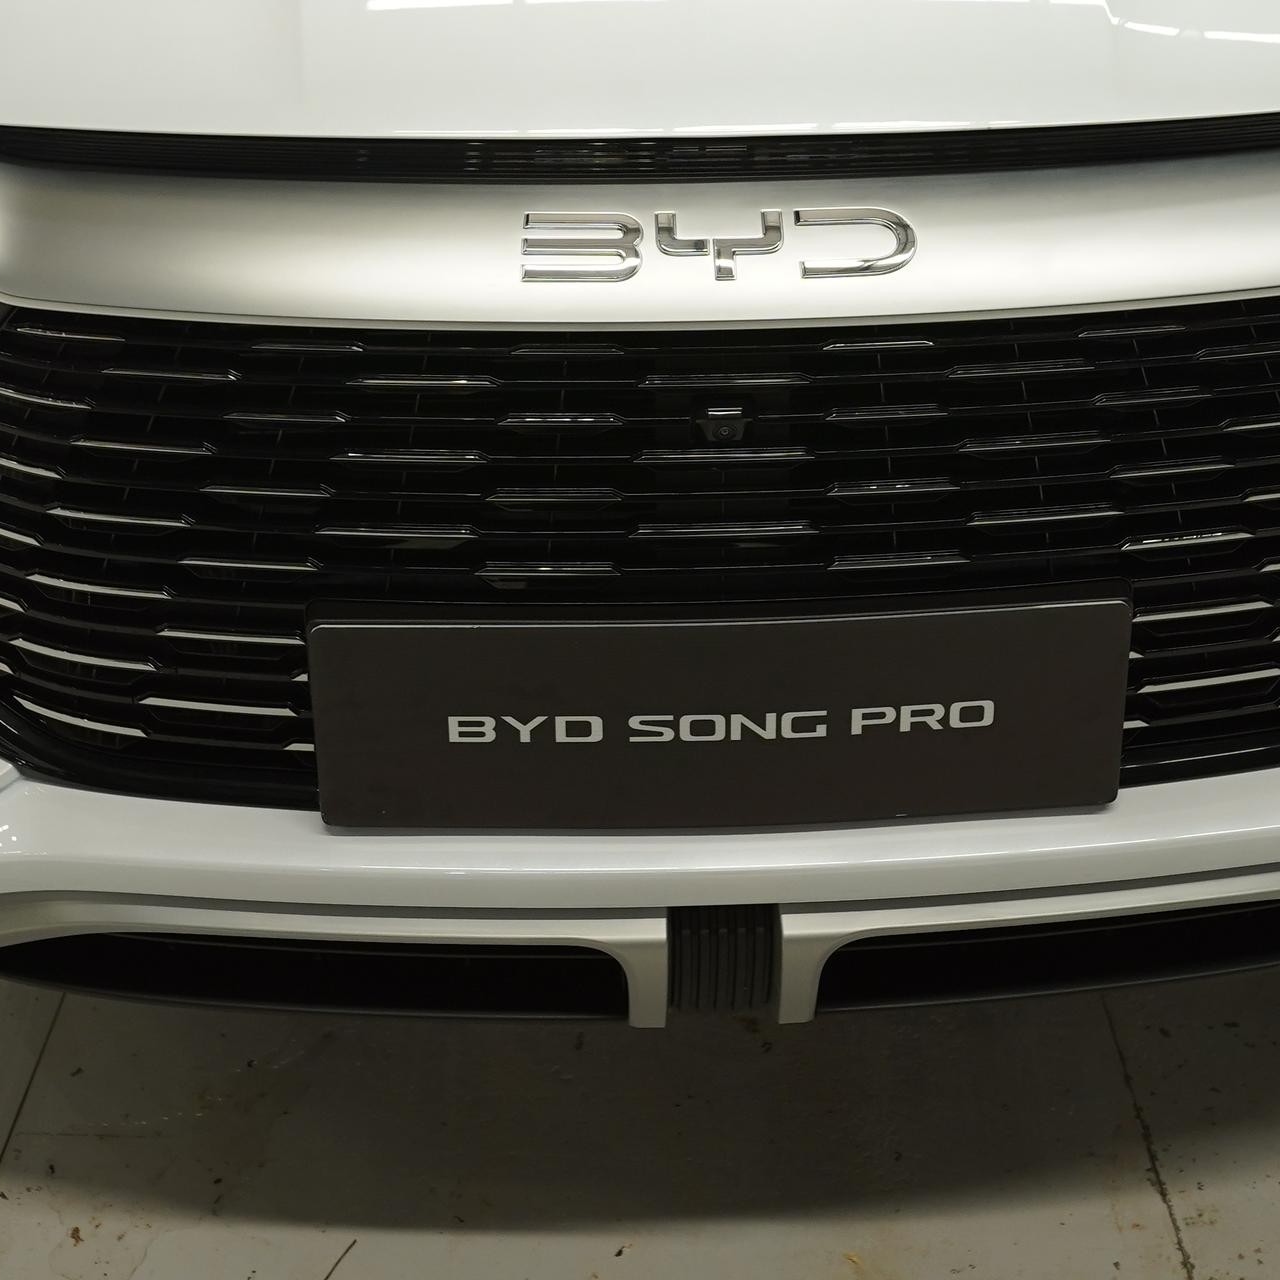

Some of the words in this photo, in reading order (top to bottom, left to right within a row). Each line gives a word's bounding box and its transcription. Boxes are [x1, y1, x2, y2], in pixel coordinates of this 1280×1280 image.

[521, 207, 918, 282] BYD
[447, 715, 604, 743] BYD
[627, 710, 828, 743] SONG
[850, 699, 995, 736] PRO
